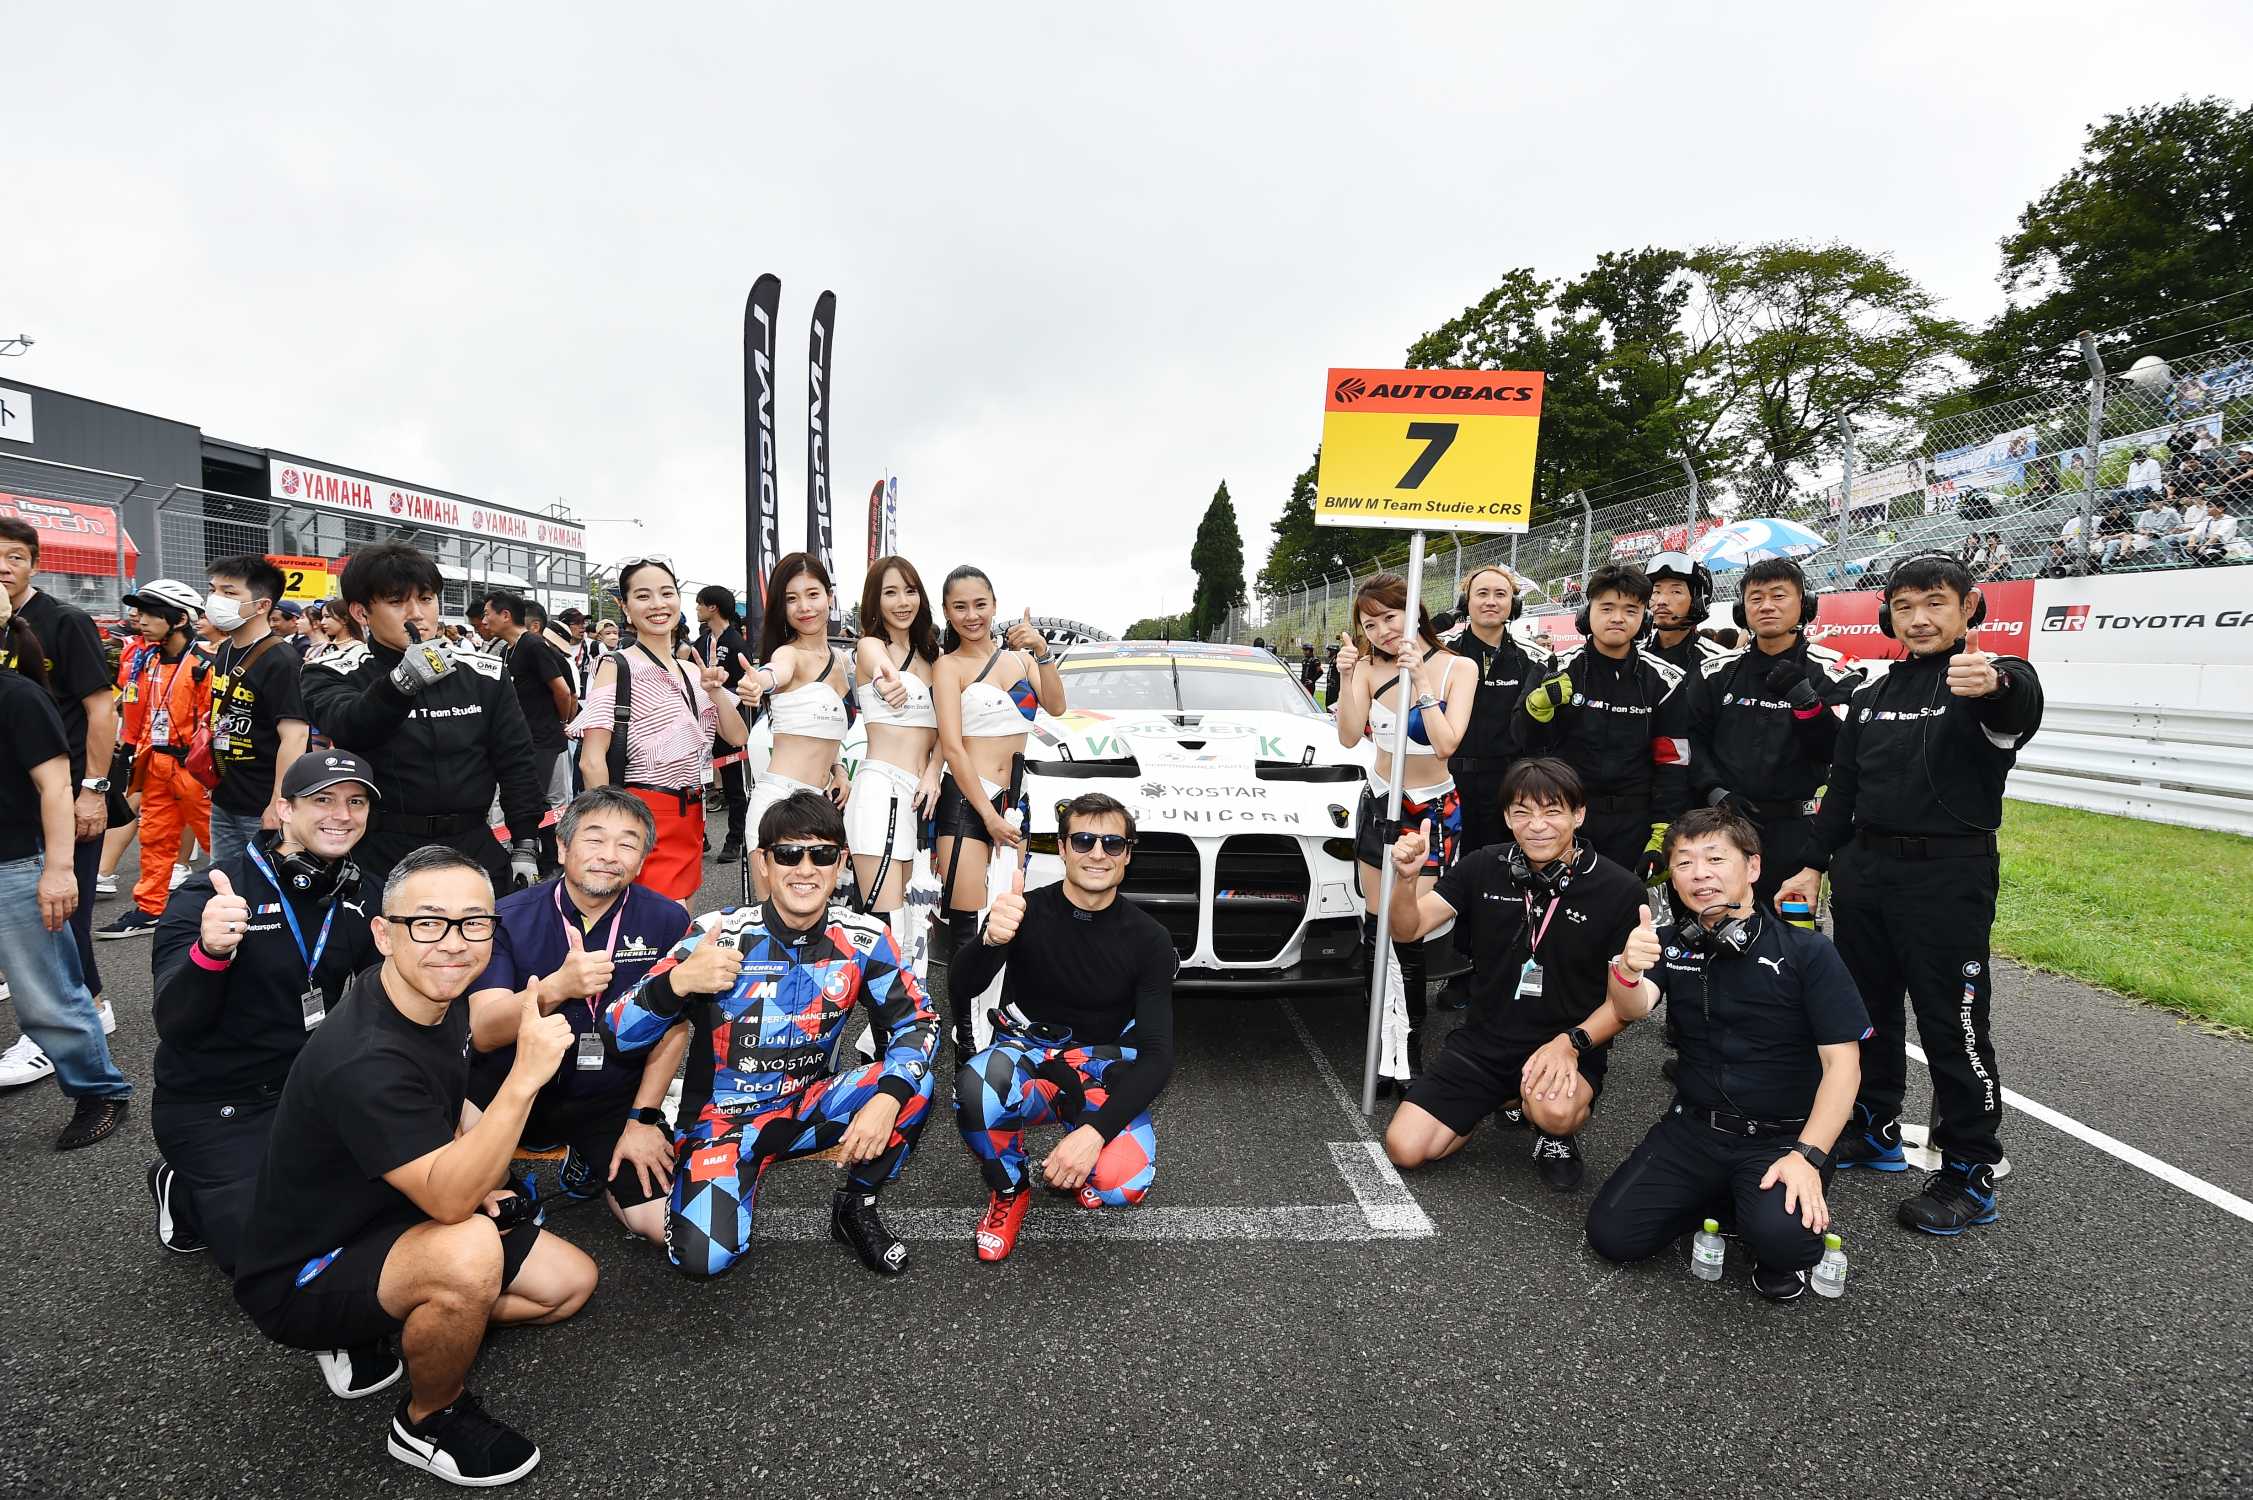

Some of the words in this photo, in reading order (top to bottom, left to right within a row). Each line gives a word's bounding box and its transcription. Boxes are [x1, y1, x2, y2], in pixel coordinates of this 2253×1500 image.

[1367, 384, 1533, 401] AUTOBACS
[1394, 422, 1460, 490] 7
[303, 471, 373, 510] YAMAHA
[405, 493, 459, 526] YAMAHA
[1324, 496, 1363, 509] BMW
[1365, 498, 1379, 510] M
[1383, 498, 1422, 512] Team
[1425, 501, 1474, 514] Studie
[1476, 505, 1486, 514] x
[1489, 503, 1522, 515] CRS
[485, 511, 528, 539] YAMAHA
[548, 526, 583, 549] YAMAHA
[286, 571, 304, 592] 2
[2042, 615, 2086, 631] GR
[2095, 614, 2205, 629] TOYOTA
[477, 661, 498, 671] OMP
[452, 704, 482, 716] Studie
[1171, 785, 1267, 799] YOSTAR
[1162, 808, 1300, 824] UNICORN
[853, 933, 873, 945] OMP
[615, 950, 658, 958] MICHELIN
[1666, 961, 1701, 973] Motorsport
[761, 1012, 828, 1023] PERFORMANCE
[766, 1031, 832, 1046] UNICORN
[760, 1052, 825, 1071] YOSTAR
[1983, 1078, 1995, 1111] PARTS
[976, 1234, 1001, 1249] OMP
